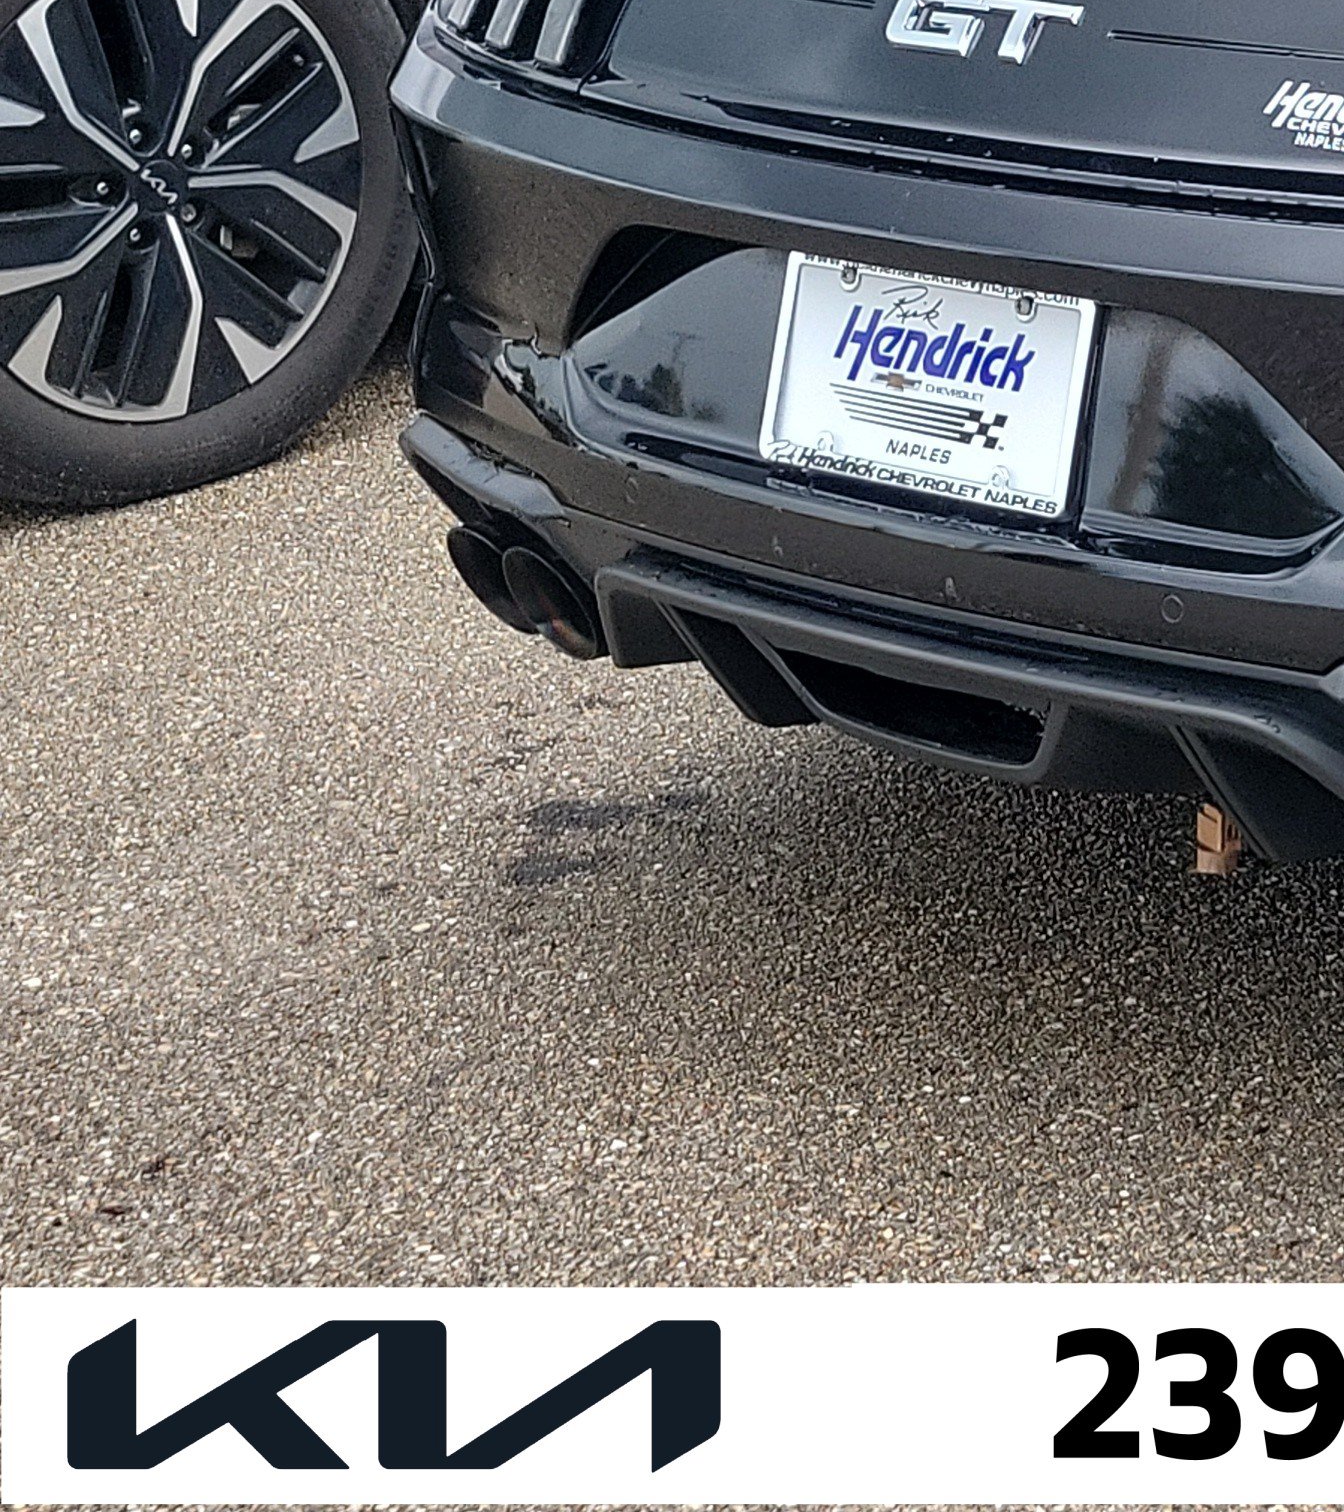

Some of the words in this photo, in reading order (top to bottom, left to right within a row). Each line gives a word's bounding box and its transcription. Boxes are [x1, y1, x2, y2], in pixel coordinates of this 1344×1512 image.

[833, 305, 1036, 392] Hendrick
[925, 383, 985, 403] CHEVROLET
[886, 438, 952, 465] NAPLES
[798, 445, 878, 479] Hendrick
[877, 467, 982, 499] CHEVROLET
[984, 488, 1058, 515] NAPLES
